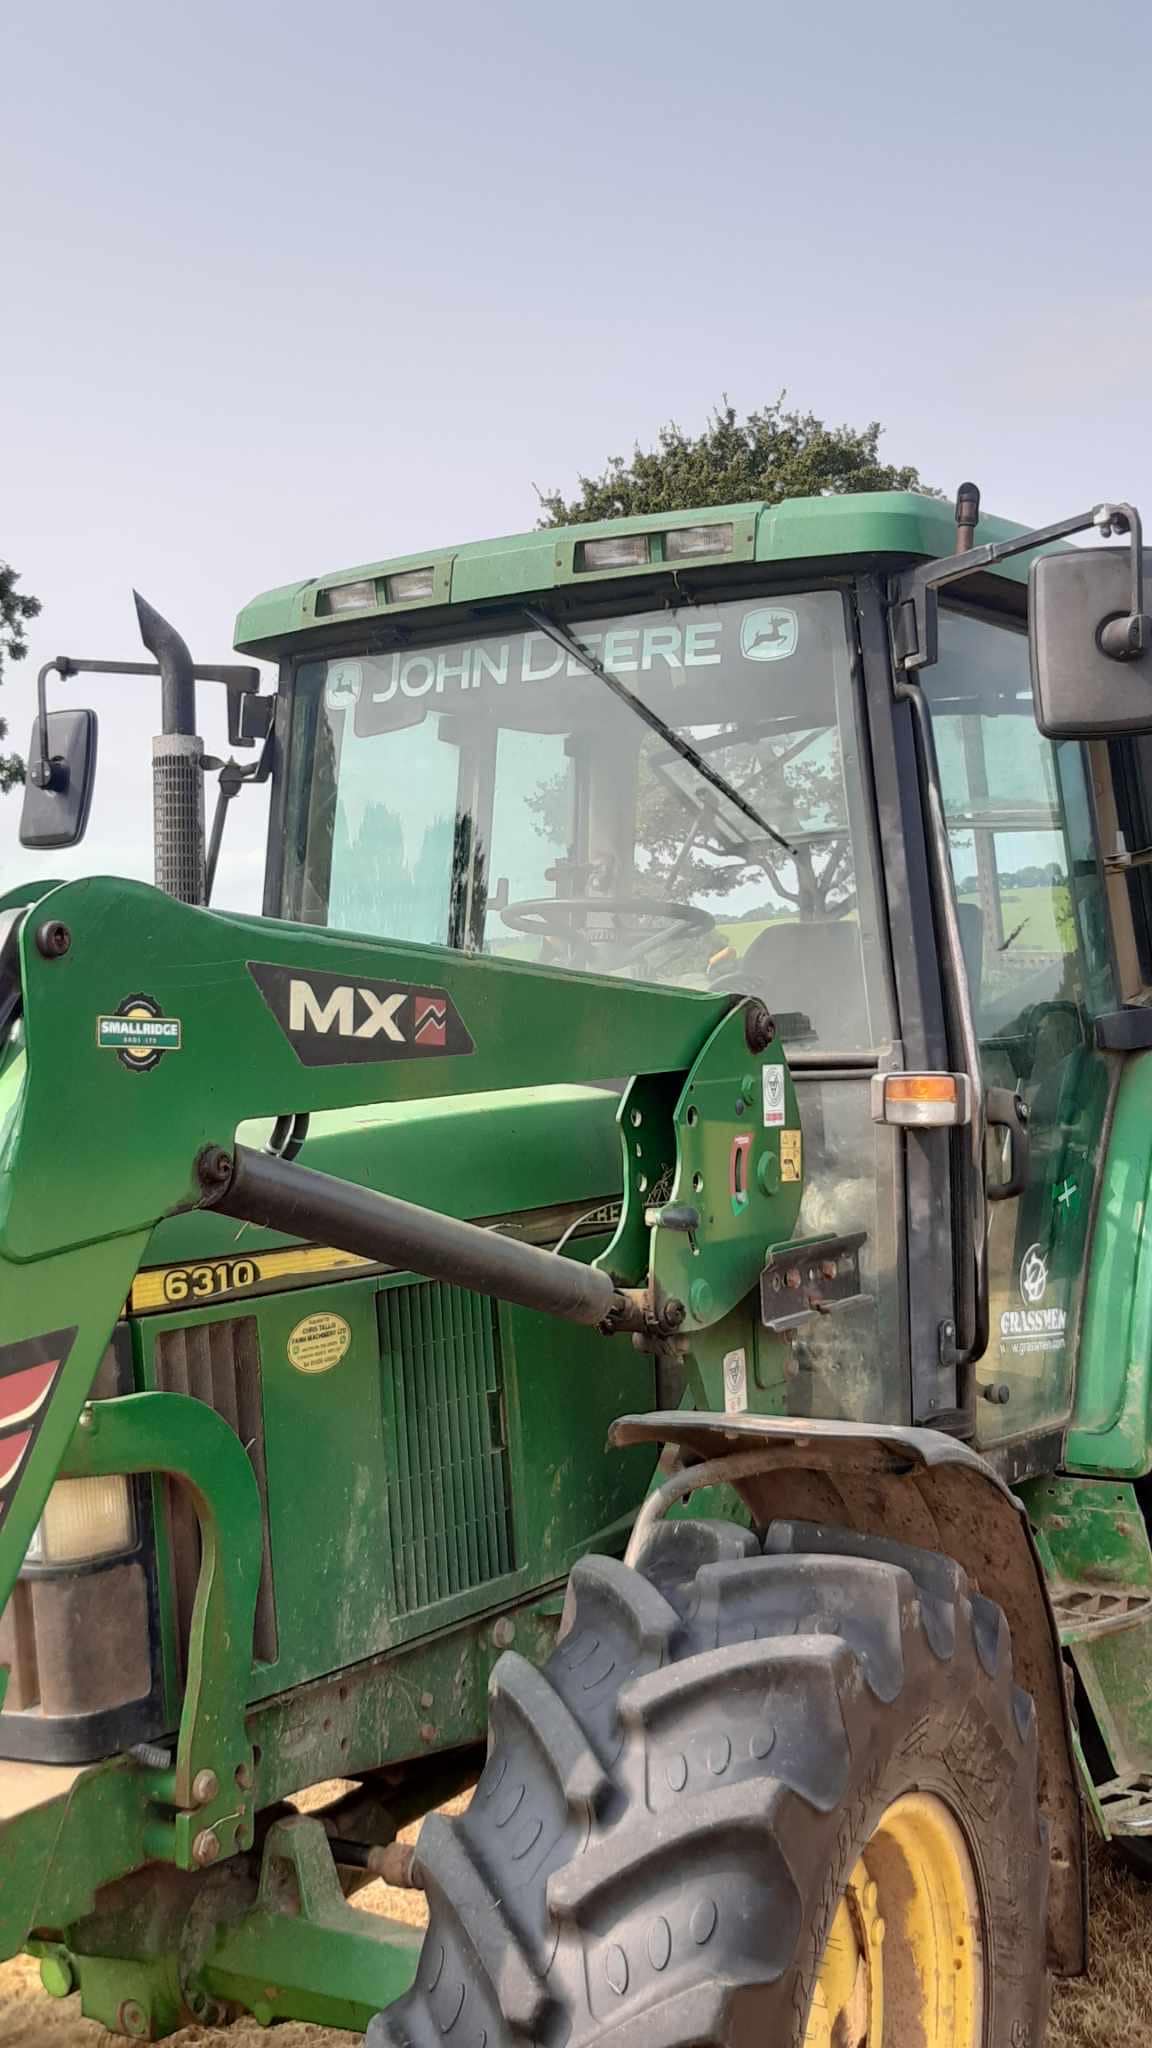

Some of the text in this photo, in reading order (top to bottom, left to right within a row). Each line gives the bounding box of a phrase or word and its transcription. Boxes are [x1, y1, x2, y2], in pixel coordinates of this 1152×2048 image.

[372, 622, 723, 703] JOHN DEERE
[289, 979, 408, 1042] MX
[101, 1021, 178, 1035] SMALLRIDGE
[164, 1260, 255, 1300] 6310
[1000, 1308, 1066, 1335] GRASSMEN
[1000, 1339, 1065, 1355] ww.grassmen.com
